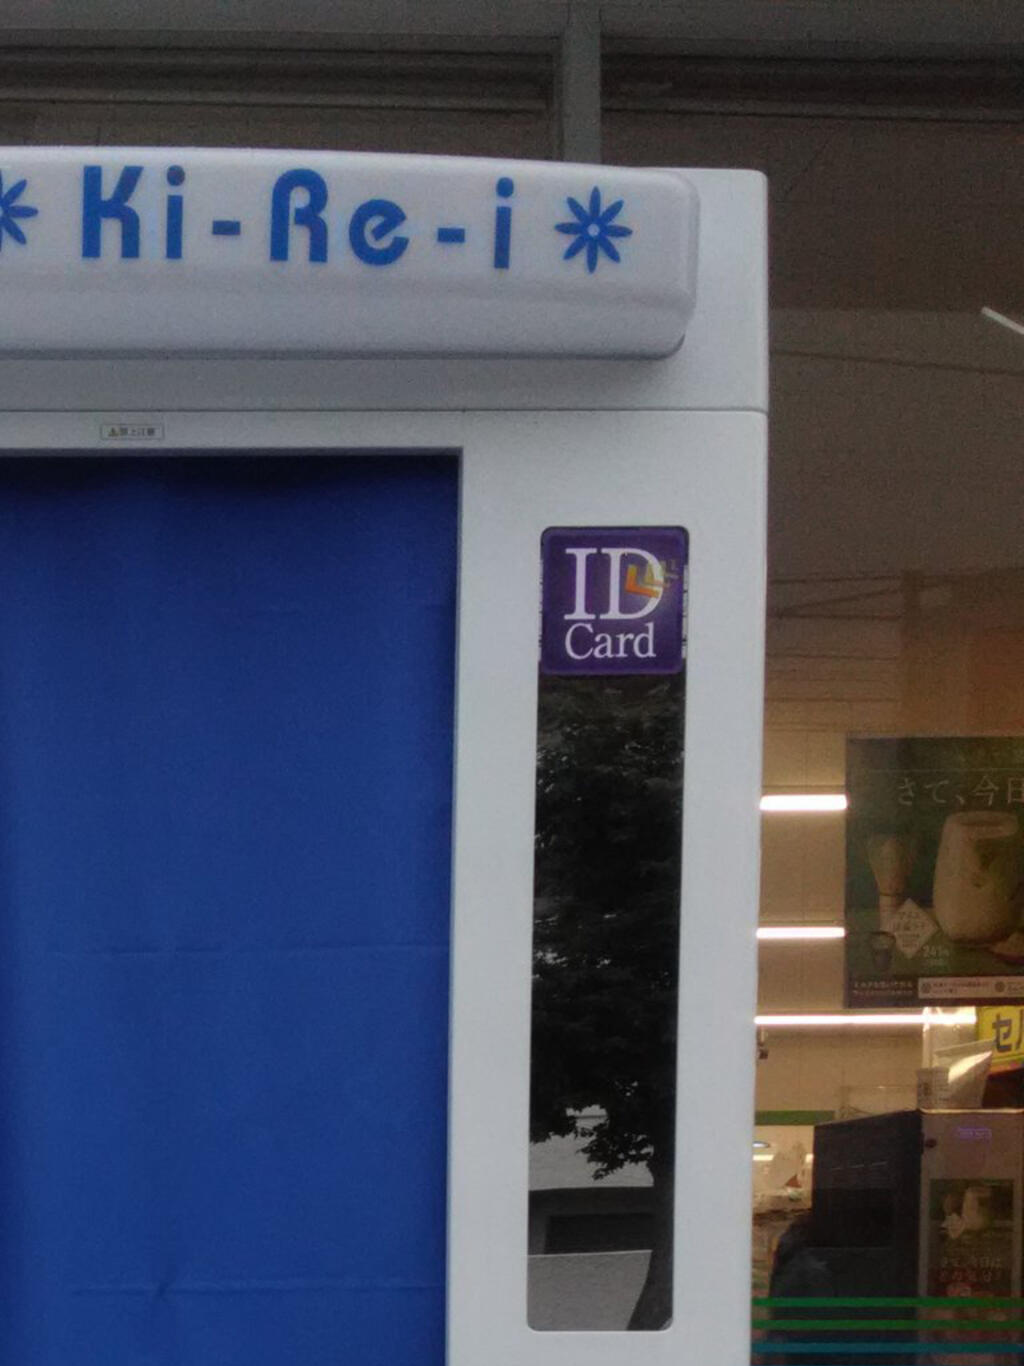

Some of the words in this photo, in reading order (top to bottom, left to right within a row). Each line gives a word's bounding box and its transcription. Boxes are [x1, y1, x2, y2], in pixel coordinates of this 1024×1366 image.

[81, 165, 513, 270] Ki-Re-i
[564, 547, 664, 620] ID
[565, 622, 657, 660] Card
